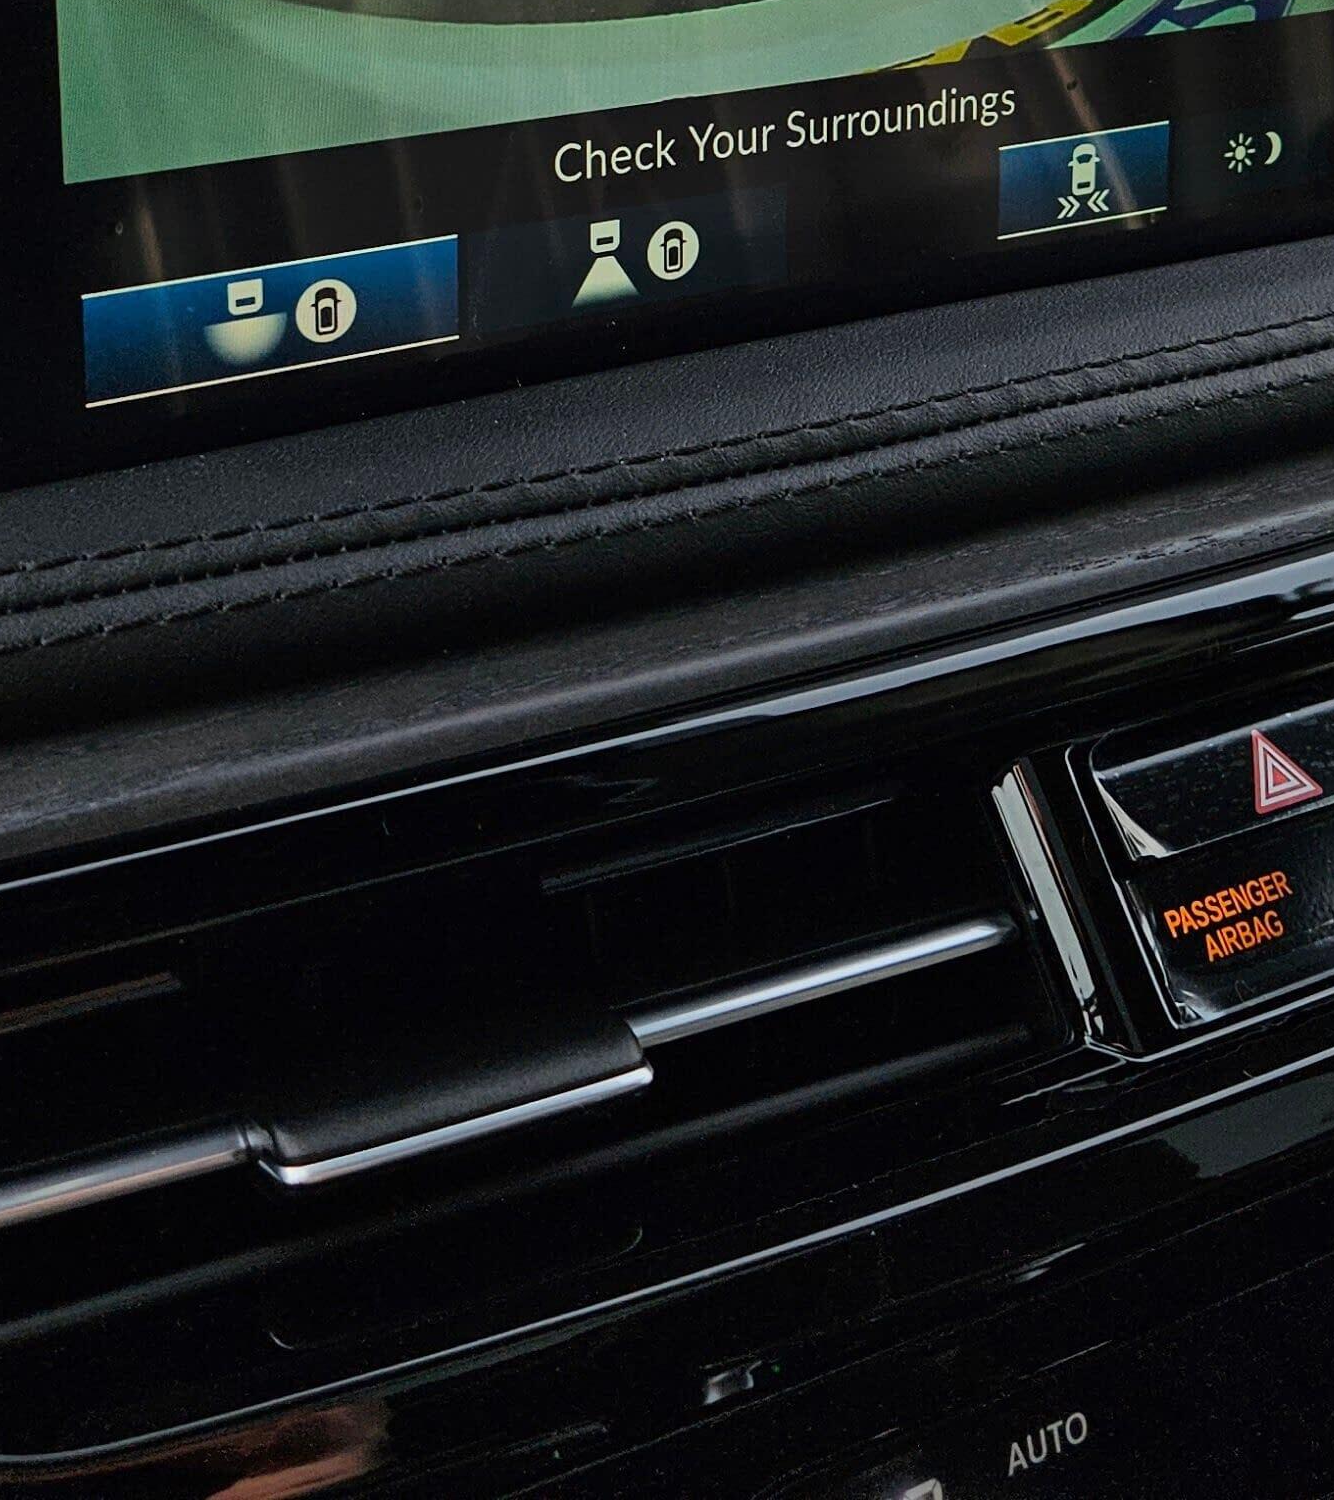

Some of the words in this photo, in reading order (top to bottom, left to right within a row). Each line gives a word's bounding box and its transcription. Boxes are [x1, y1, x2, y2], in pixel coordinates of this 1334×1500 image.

[553, 129, 677, 184] Check
[689, 120, 777, 163] Your
[785, 86, 1017, 149] Surroundings
[1163, 870, 1294, 939] PASSENGER
[1204, 911, 1285, 963] AIRBAG
[1007, 1411, 1089, 1477] AUTO
